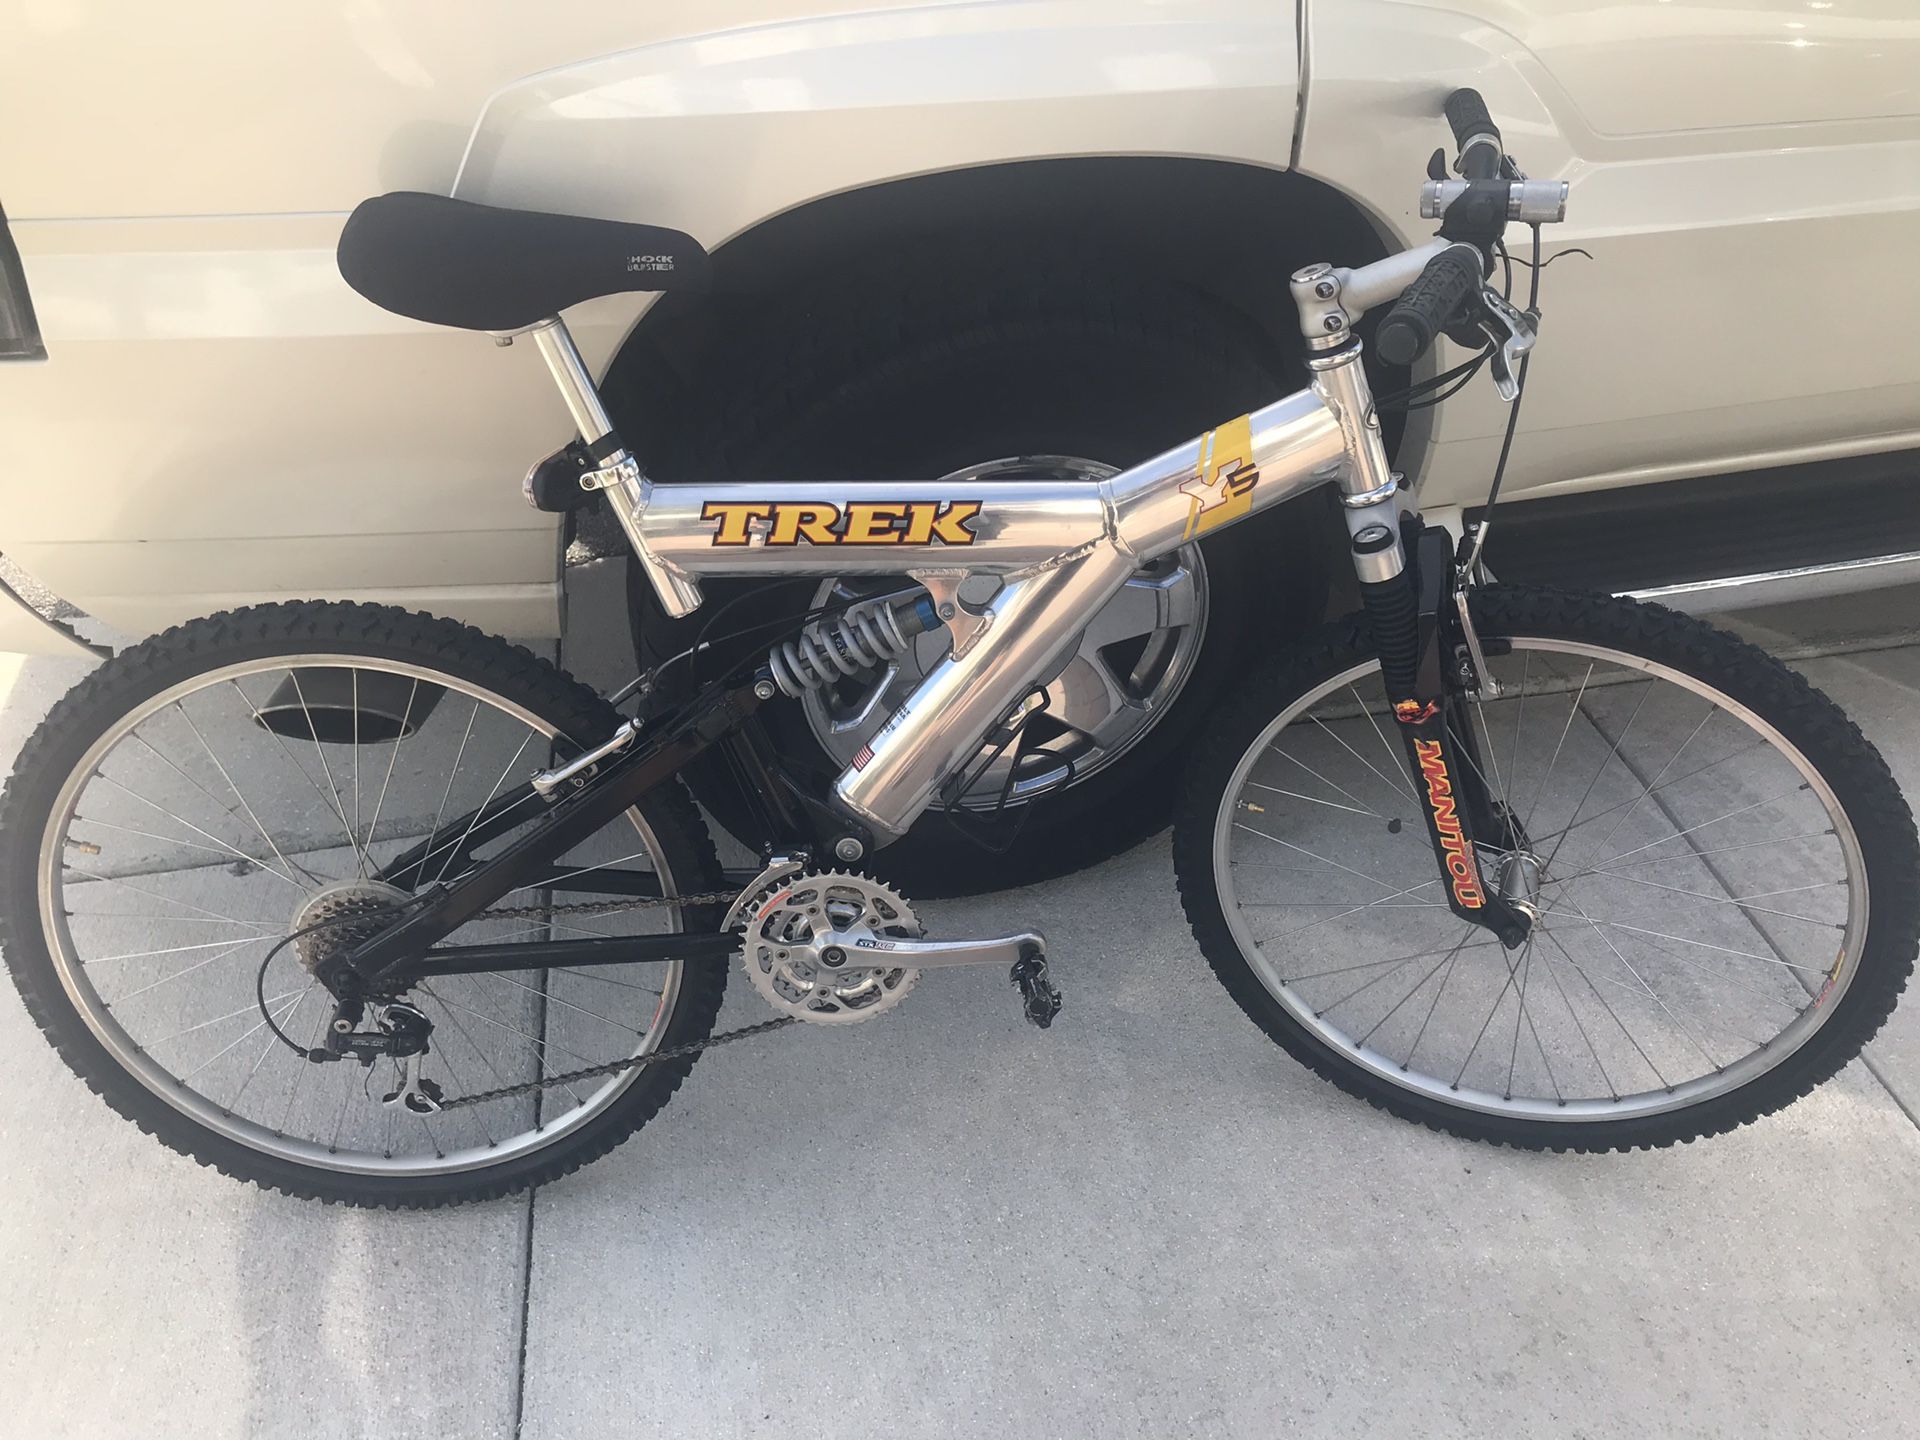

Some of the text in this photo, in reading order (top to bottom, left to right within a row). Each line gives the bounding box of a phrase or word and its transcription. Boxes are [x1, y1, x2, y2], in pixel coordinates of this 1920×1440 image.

[626, 255, 674, 263] HOCK
[700, 500, 983, 547] TREK
[1413, 737, 1483, 908] MANITOU
